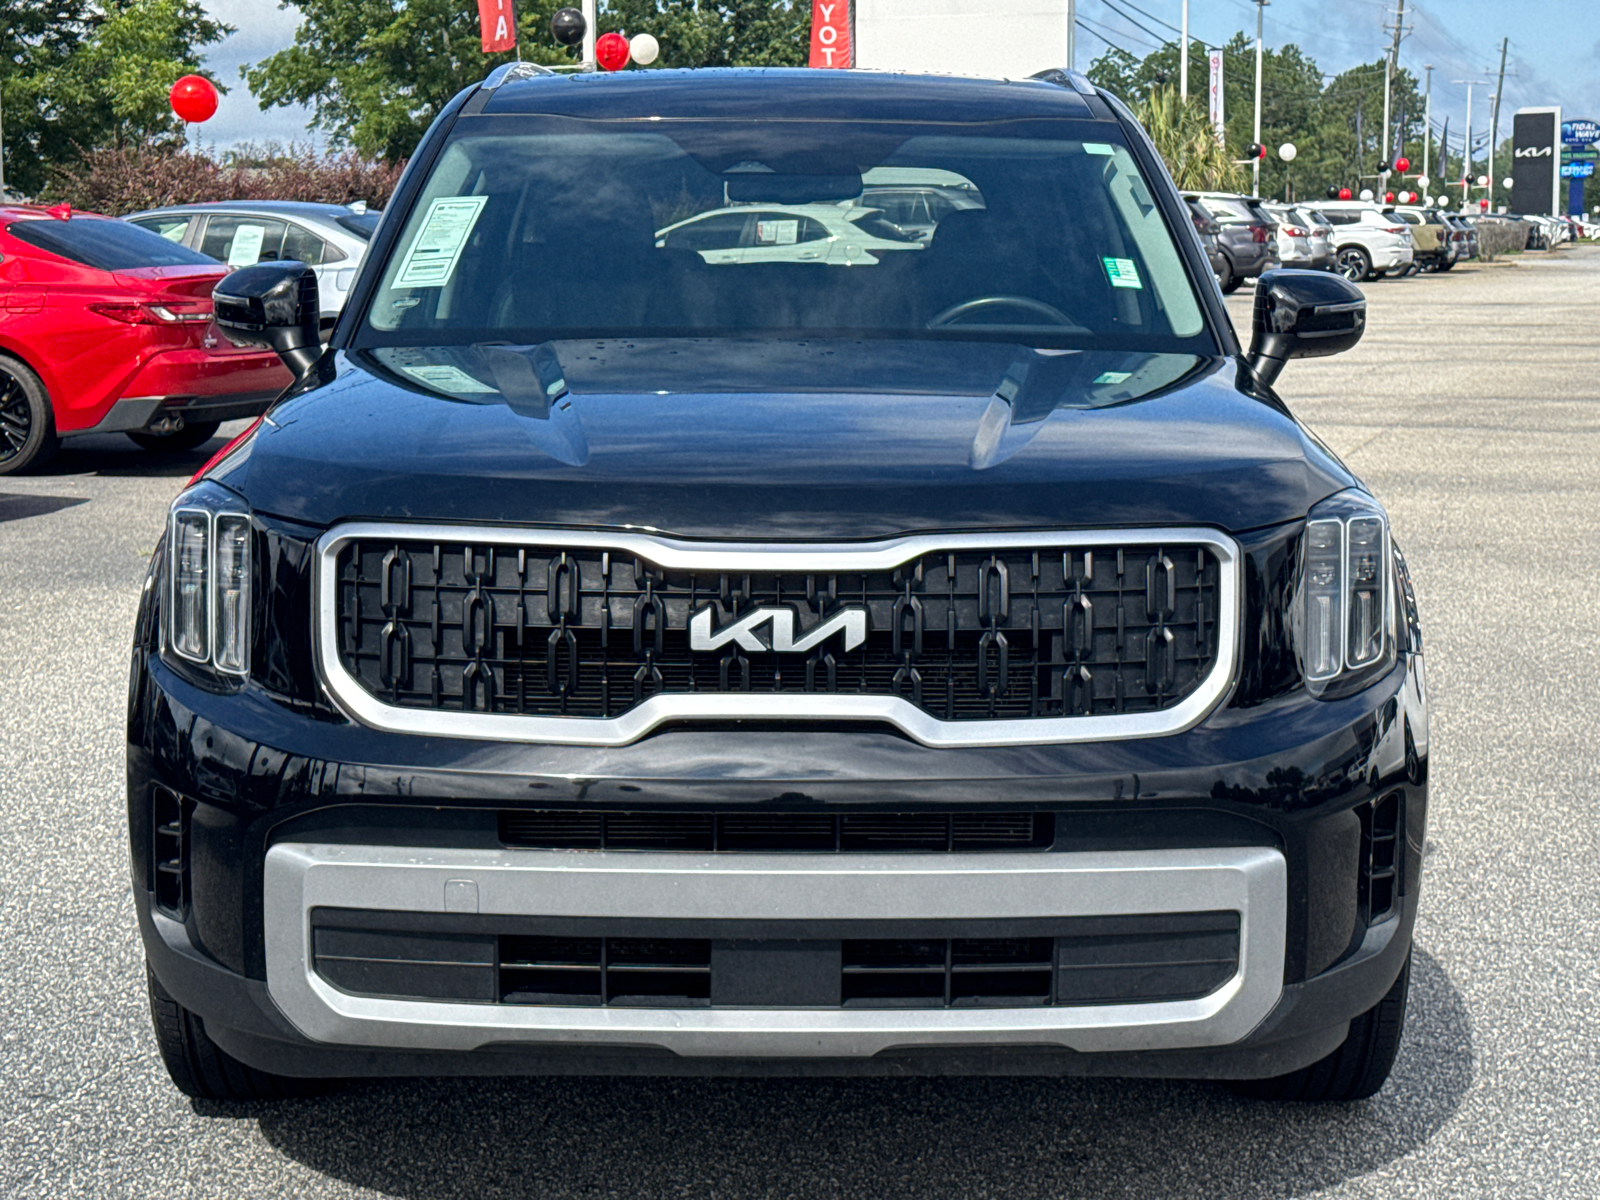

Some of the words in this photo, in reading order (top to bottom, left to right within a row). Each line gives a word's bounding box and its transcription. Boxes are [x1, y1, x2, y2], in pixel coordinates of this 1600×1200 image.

[1572, 123, 1596, 131] TIDAL
[1575, 130, 1600, 138] WAVE
[1515, 146, 1552, 157] KIA
[690, 607, 866, 652] KIA
